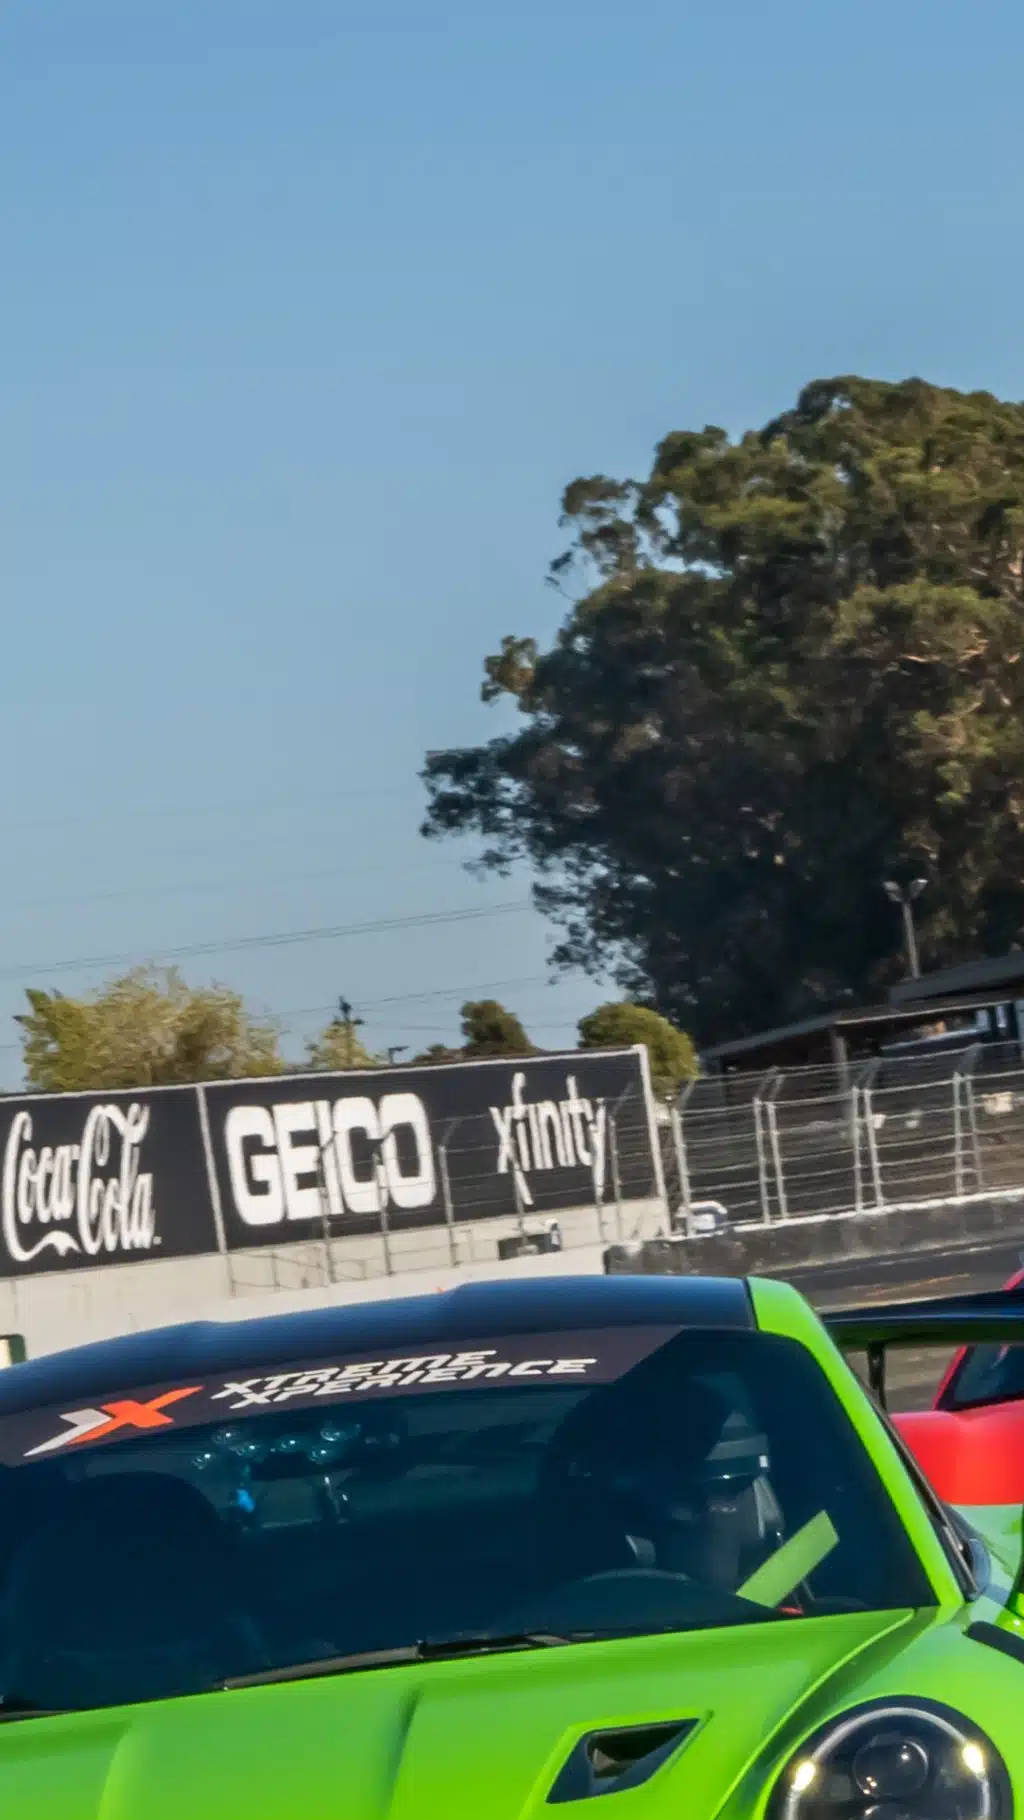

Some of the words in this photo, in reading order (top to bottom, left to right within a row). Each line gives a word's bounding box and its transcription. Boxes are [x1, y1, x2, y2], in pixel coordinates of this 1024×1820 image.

[225, 1093, 436, 1225] GEICO
[489, 1072, 606, 1205] xfinity
[211, 1350, 497, 1399] XTREME
[229, 1358, 598, 1409] XPERIENCE
